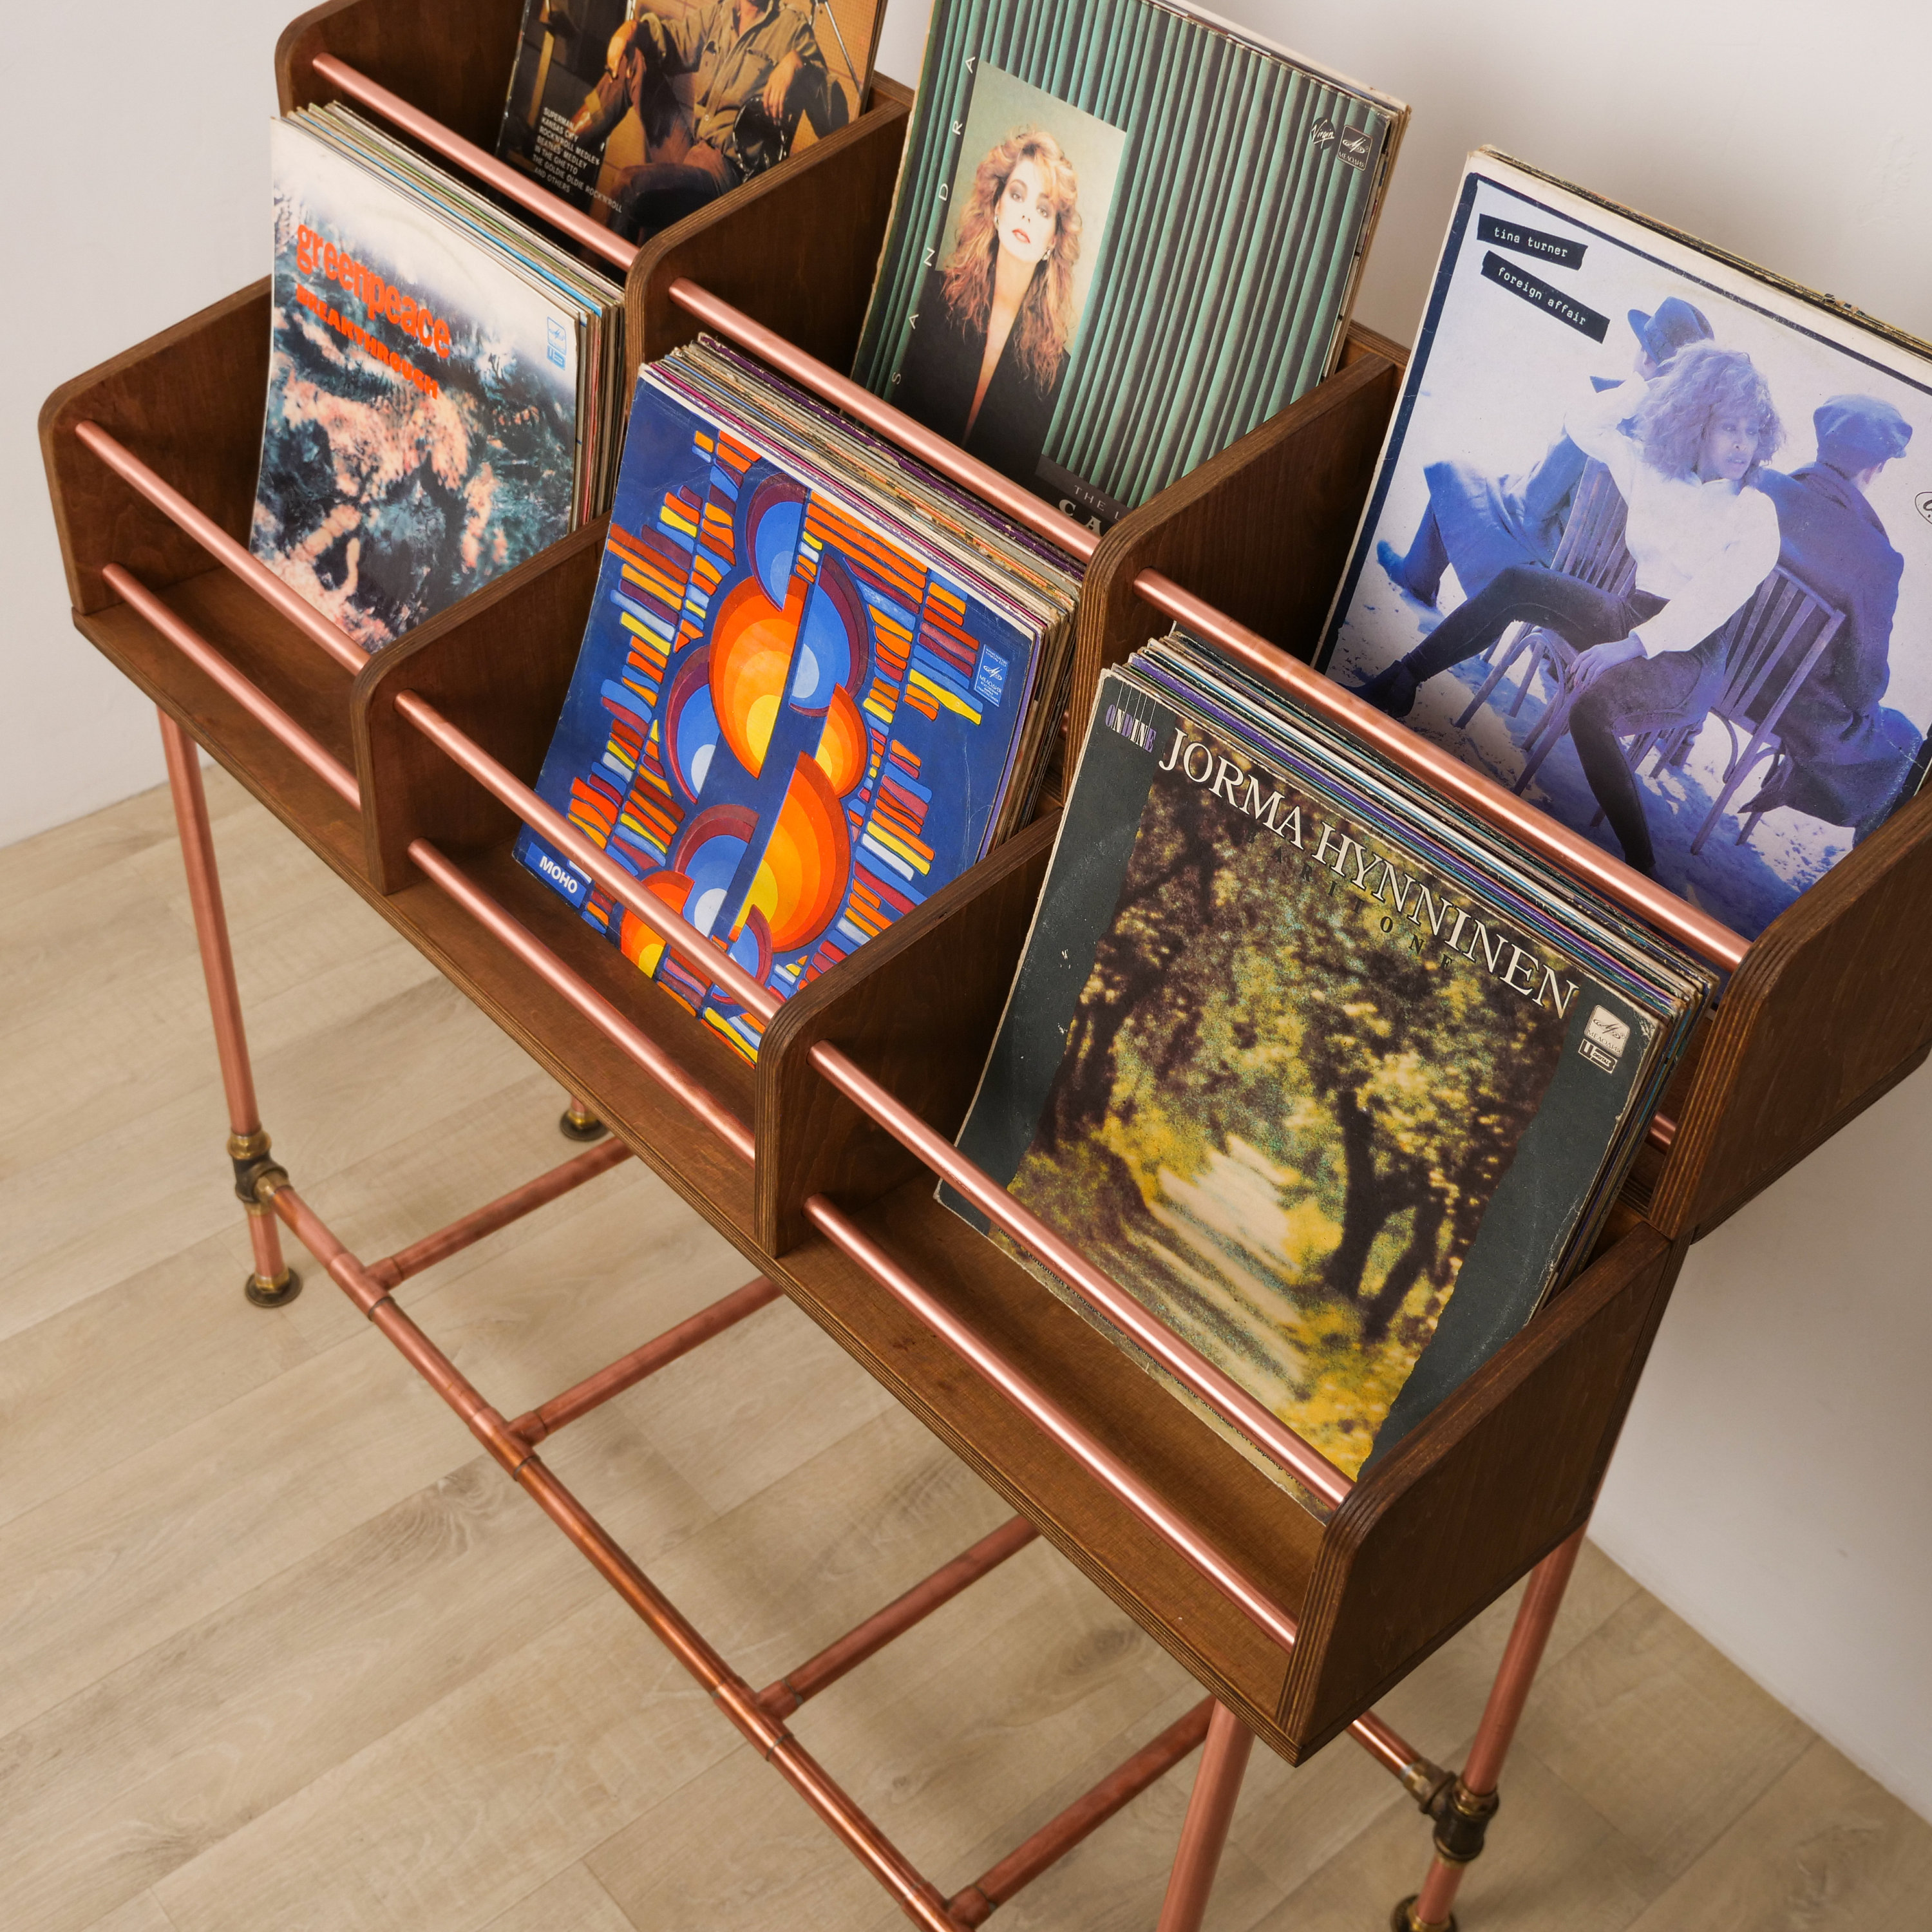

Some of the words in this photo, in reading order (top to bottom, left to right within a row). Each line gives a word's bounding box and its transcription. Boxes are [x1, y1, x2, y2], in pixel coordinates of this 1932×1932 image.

[541, 117, 564, 134] KANSAS
[564, 128, 580, 142] CITY
[544, 106, 574, 129] SUPERMAN
[1311, 118, 1335, 149] Virgin
[534, 145, 542, 155] IN
[542, 149, 553, 161] THE
[554, 155, 578, 175] GHETTO
[564, 151, 588, 170] MEDLEY
[576, 146, 600, 166] MEDLEY
[532, 154, 543, 166] THE
[544, 161, 565, 179] GOLDIE
[566, 174, 584, 191] OLDIE
[535, 167, 547, 178] AND
[1494, 227, 1520, 243] tina
[1528, 236, 1568, 258] turner
[296, 223, 451, 359] greenpeace
[1497, 267, 1542, 300] foreign
[1547, 298, 1586, 325] affair
[296, 282, 439, 401] BREAKTHROUGH
[1074, 484, 1106, 512] THE
[1105, 704, 1157, 753] ONDINE
[1159, 727, 1304, 850] JORMA
[1311, 821, 1580, 1019] HYNNINEN
[1586, 1030, 1622, 1054] МЕЛОДИЯ
[1593, 1052, 1609, 1065] DIGITAL
